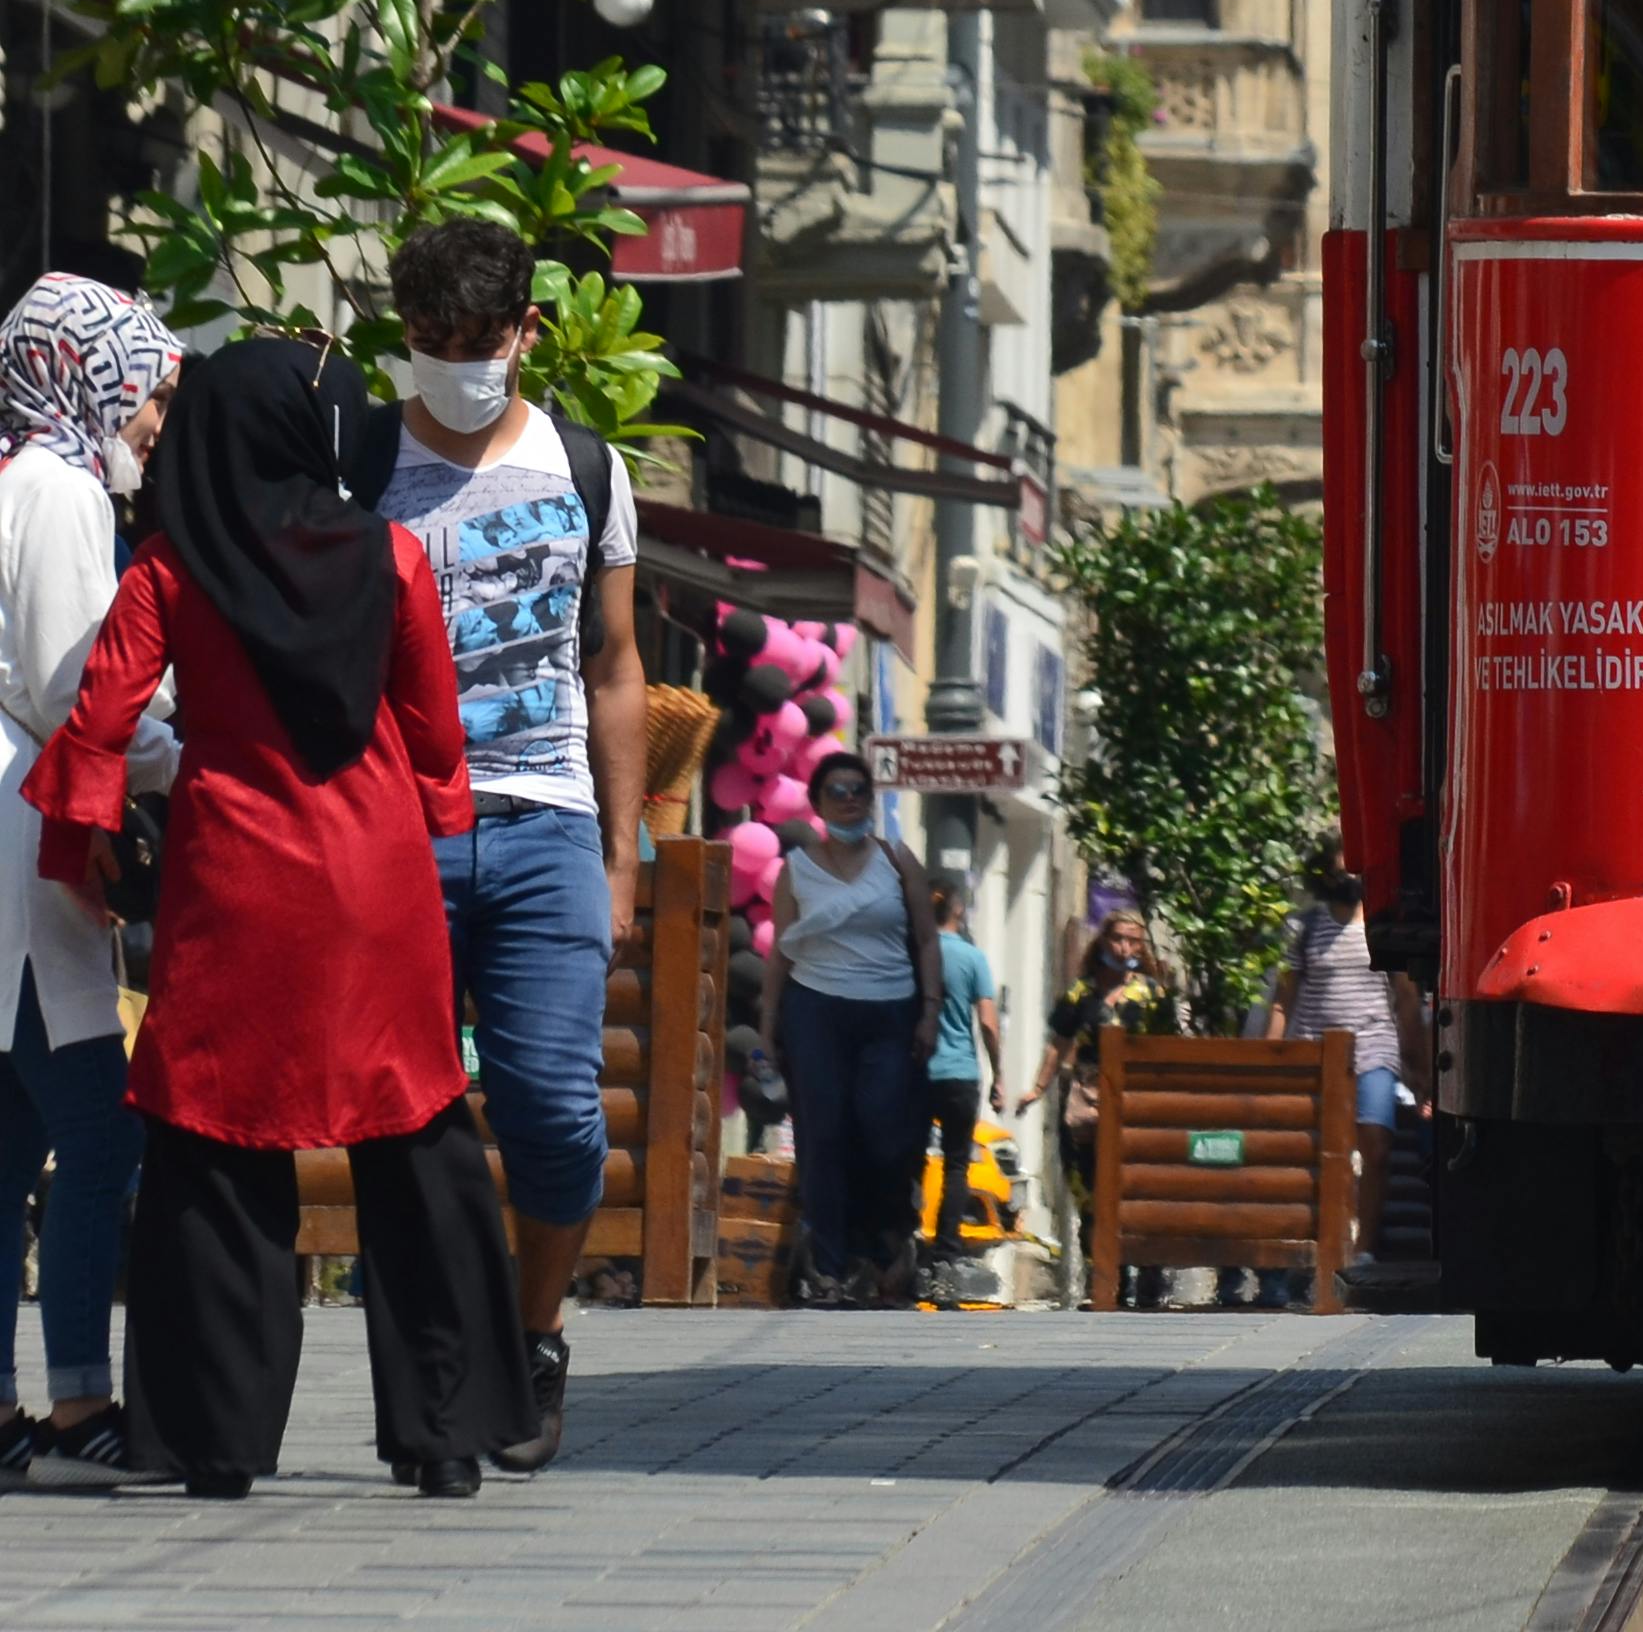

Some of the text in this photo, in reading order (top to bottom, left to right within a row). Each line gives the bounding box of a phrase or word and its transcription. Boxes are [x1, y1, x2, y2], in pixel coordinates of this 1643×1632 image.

[1500, 347, 1568, 437] 223
[1507, 482, 1609, 501] www.iett.gov.tr
[1506, 518, 1609, 547] ALO 153
[1477, 601, 1554, 636] ASILMAK
[1474, 655, 1490, 691] VE
